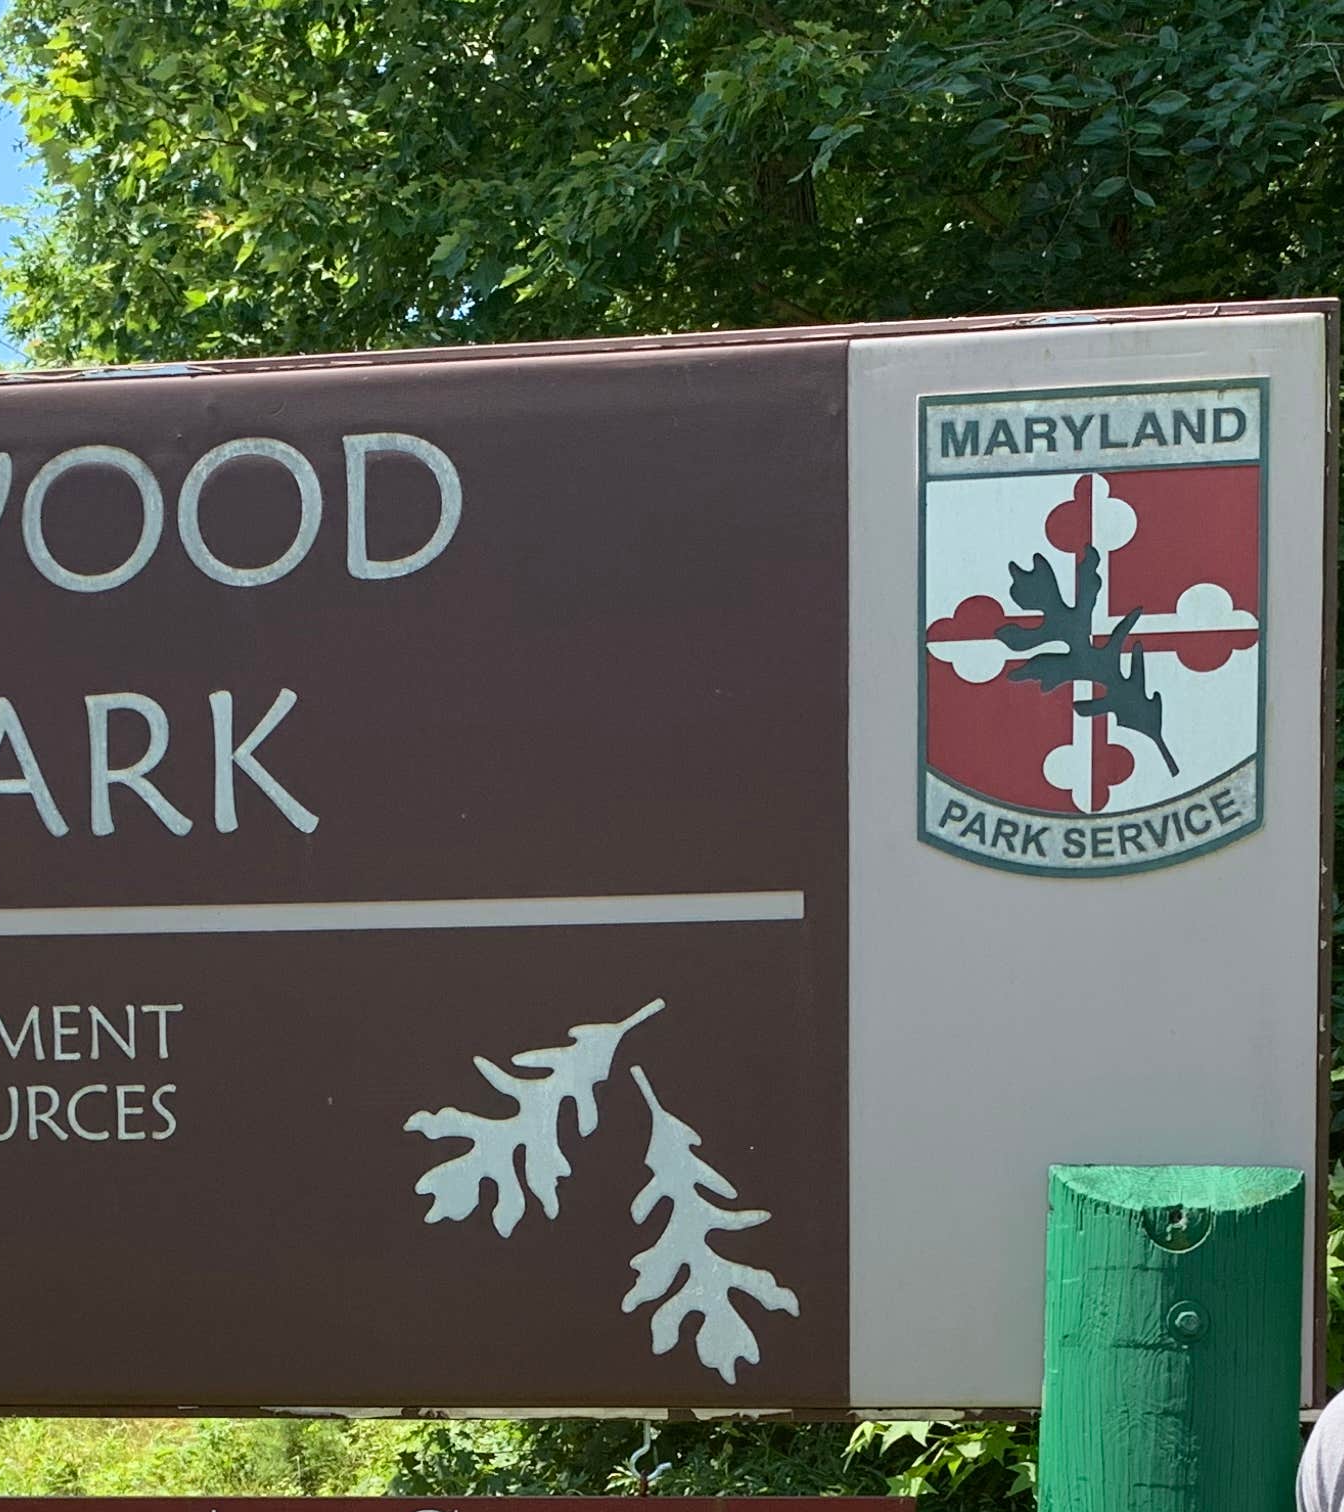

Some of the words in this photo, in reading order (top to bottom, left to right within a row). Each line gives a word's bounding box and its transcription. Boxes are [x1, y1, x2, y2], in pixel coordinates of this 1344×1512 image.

[939, 406, 1248, 459] MARYLAND
[938, 799, 1049, 858] PARK
[1061, 788, 1244, 860] SERVICE
